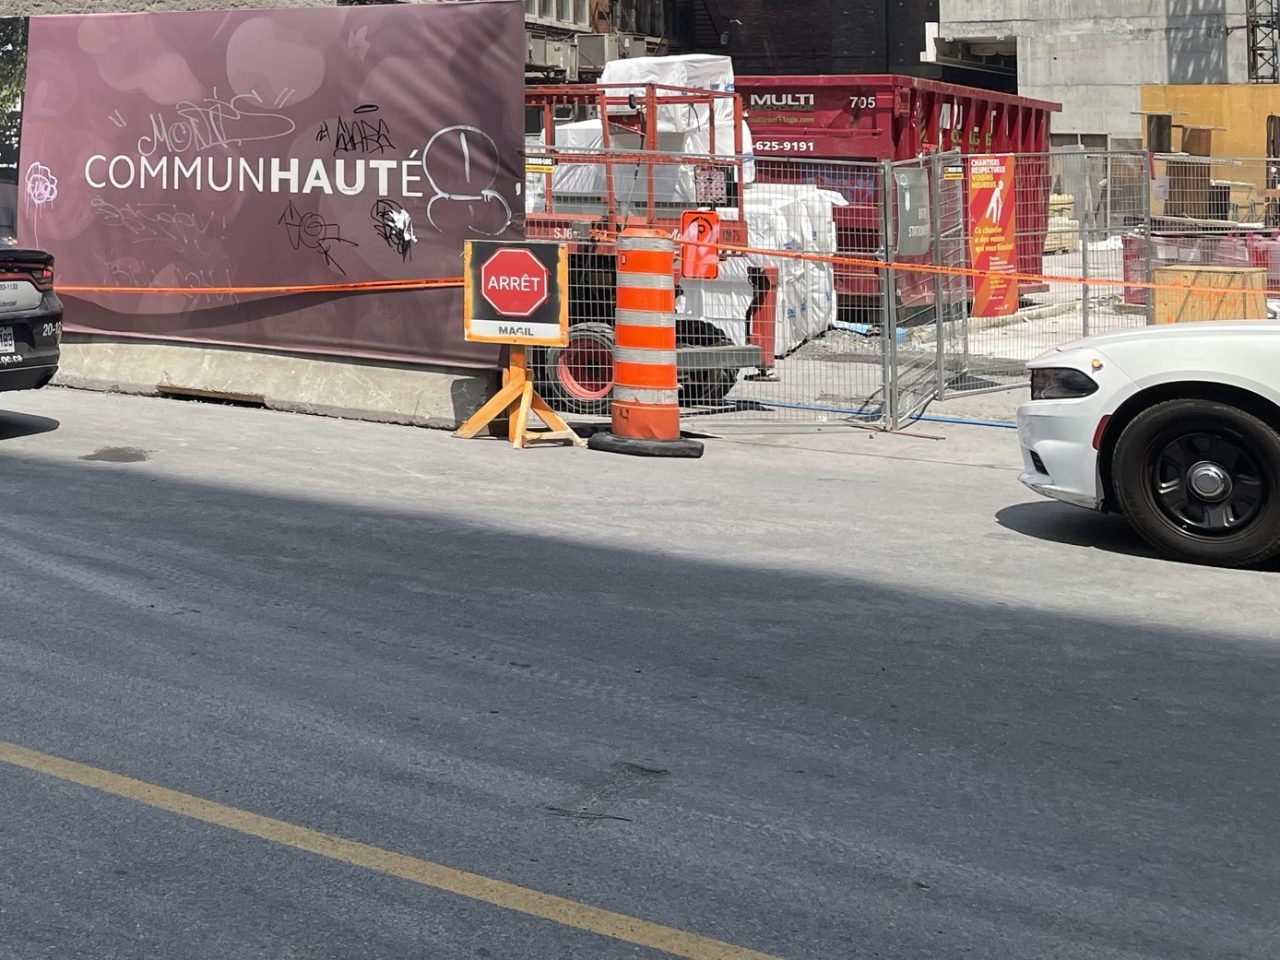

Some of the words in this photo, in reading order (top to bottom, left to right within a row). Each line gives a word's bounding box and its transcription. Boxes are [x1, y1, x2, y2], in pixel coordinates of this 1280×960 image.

[750, 94, 814, 106] MULTI
[849, 96, 876, 109] 705
[85, 149, 423, 198] COMMUNHAUTÉ
[487, 273, 541, 292] ARRÊT
[498, 325, 534, 337] MAGIL
